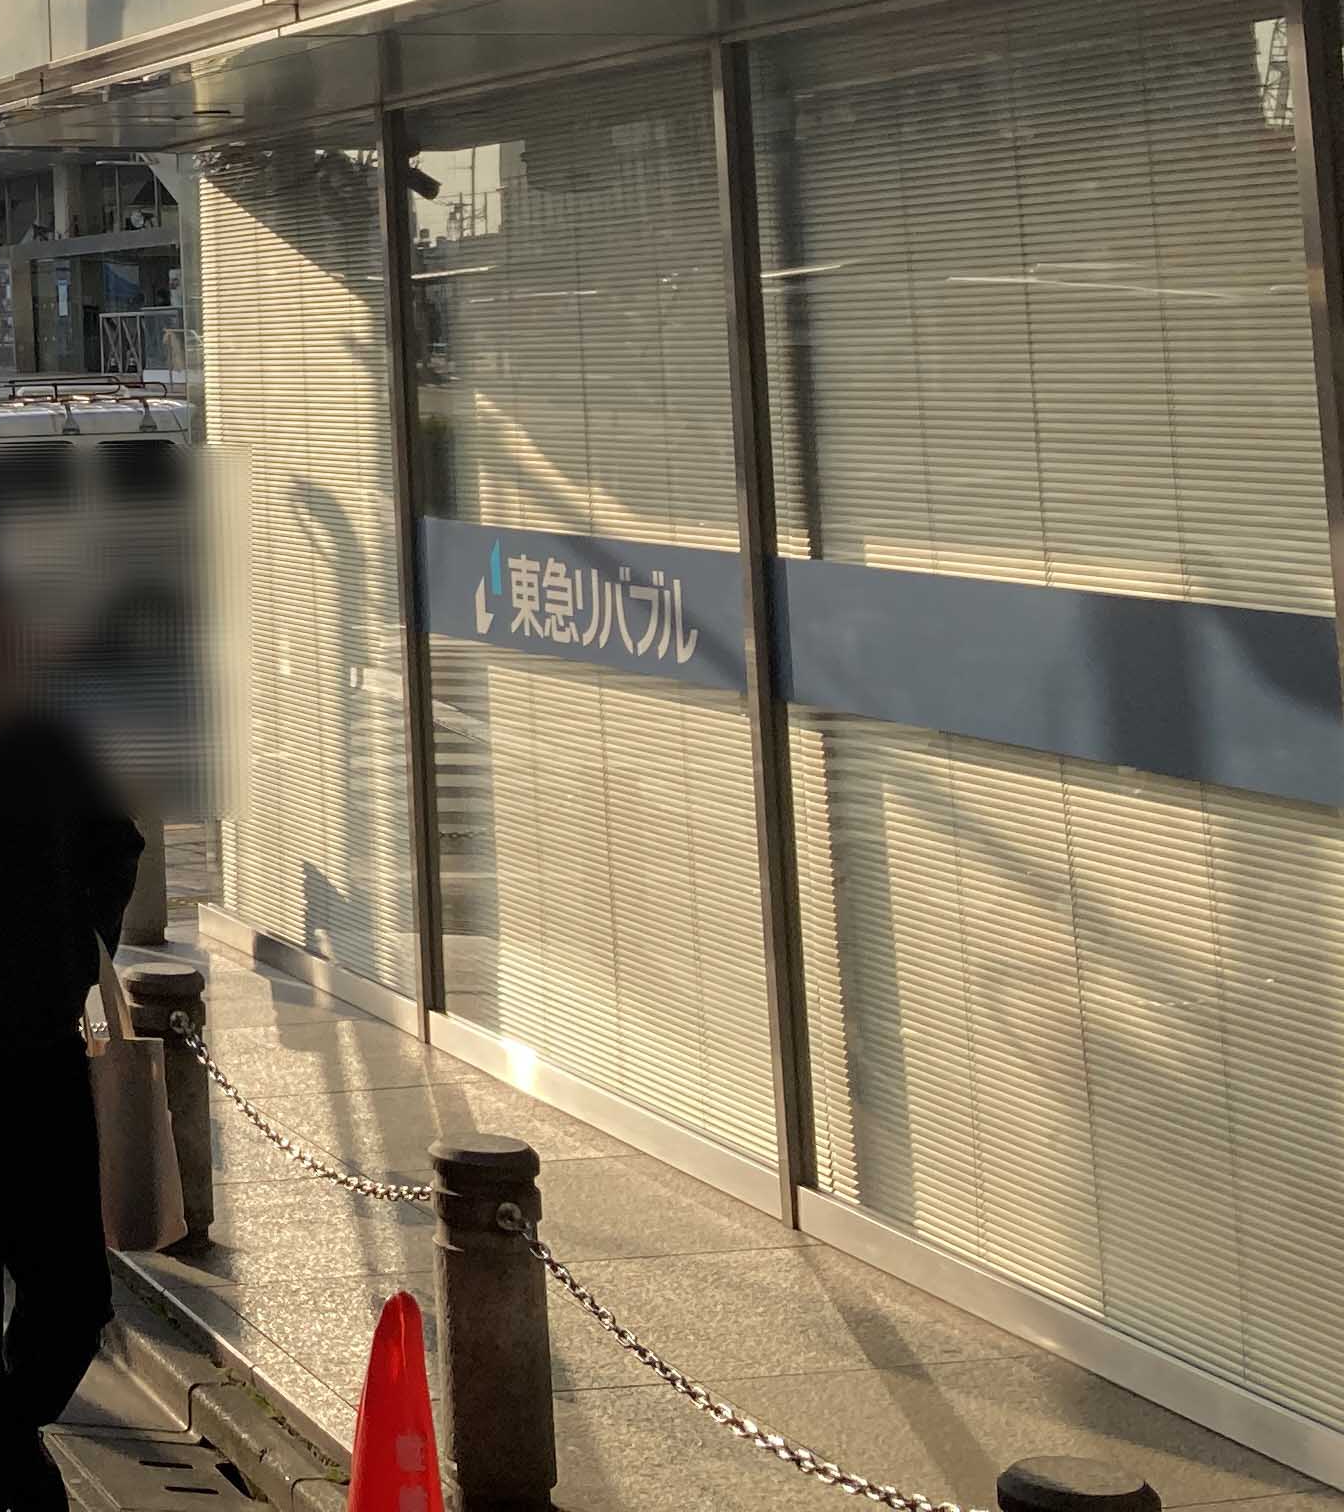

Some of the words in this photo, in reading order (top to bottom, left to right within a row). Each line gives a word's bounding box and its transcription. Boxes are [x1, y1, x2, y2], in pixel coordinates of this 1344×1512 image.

[507, 553, 699, 665] 東急リバブル
